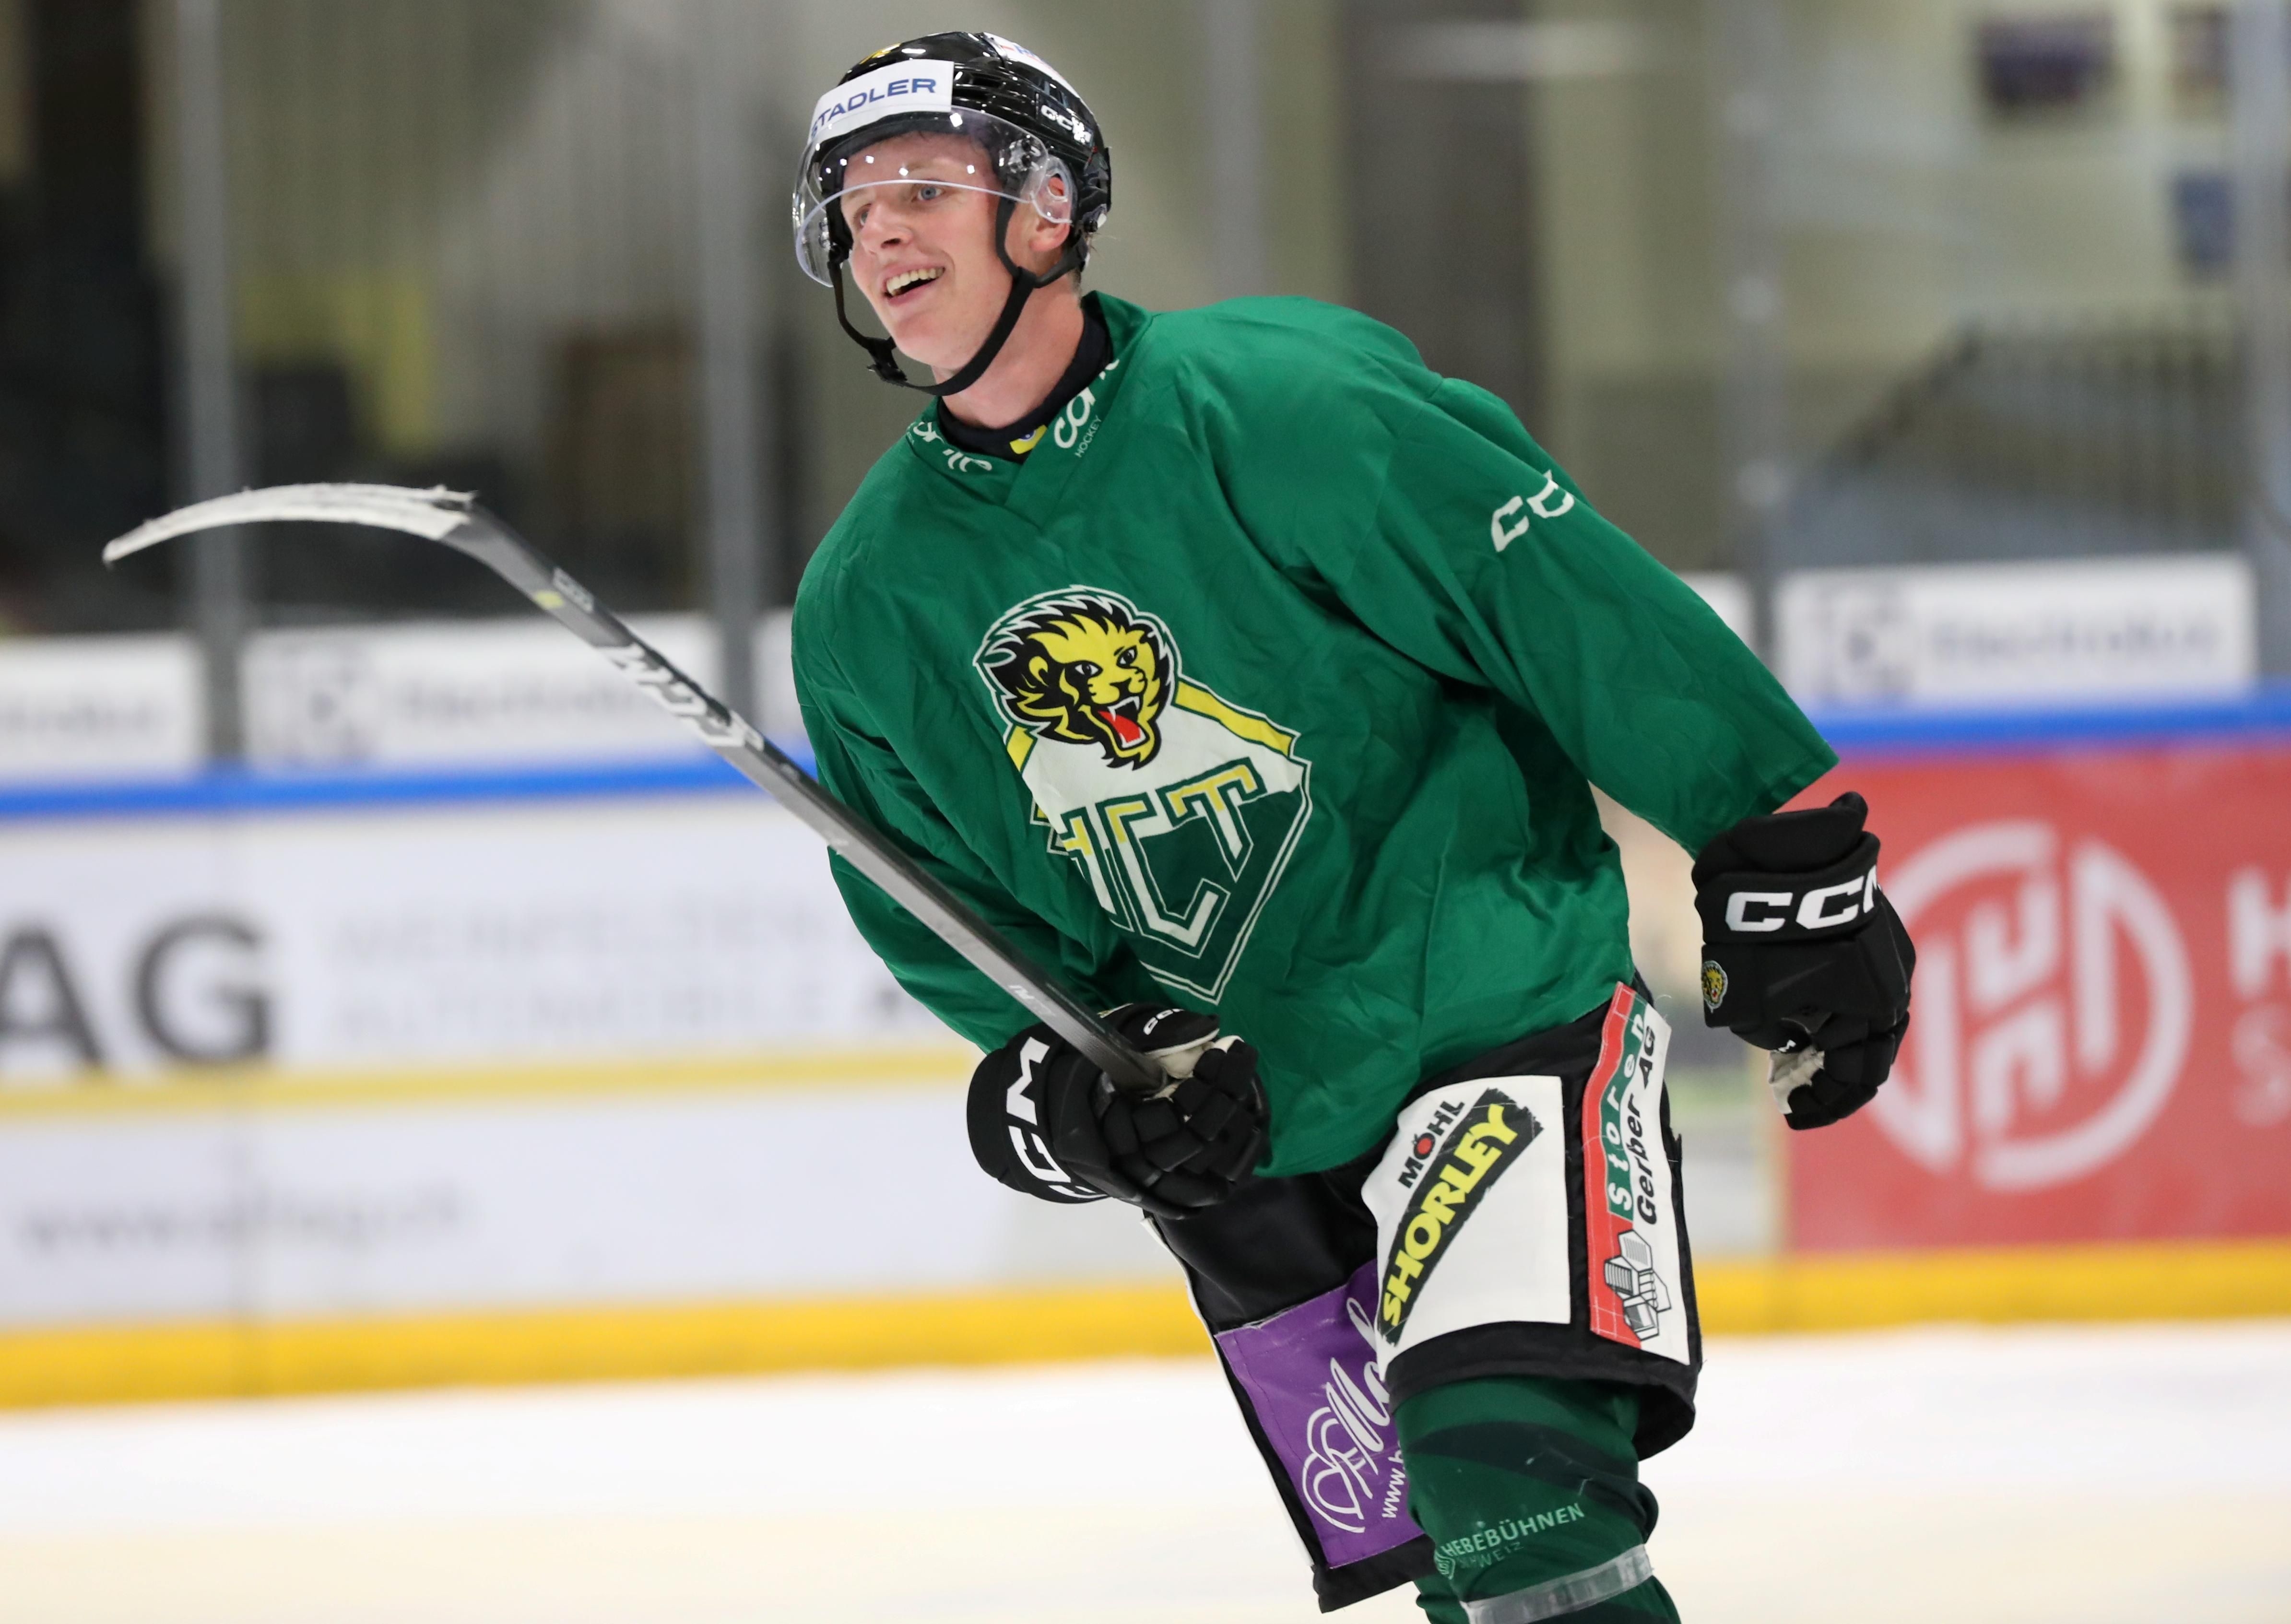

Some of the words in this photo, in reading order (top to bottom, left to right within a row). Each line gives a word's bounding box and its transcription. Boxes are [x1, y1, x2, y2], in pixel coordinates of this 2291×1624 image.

[1075, 415, 1102, 458] HOCKEY
[1639, 1025, 1656, 1090] AG
[1607, 1013, 1644, 1211] Storen
[1627, 1092, 1657, 1225] Gerber
[1382, 1104, 1519, 1327] SHORLEY
[1441, 1502, 1585, 1557] HEBEBÜHNEN
